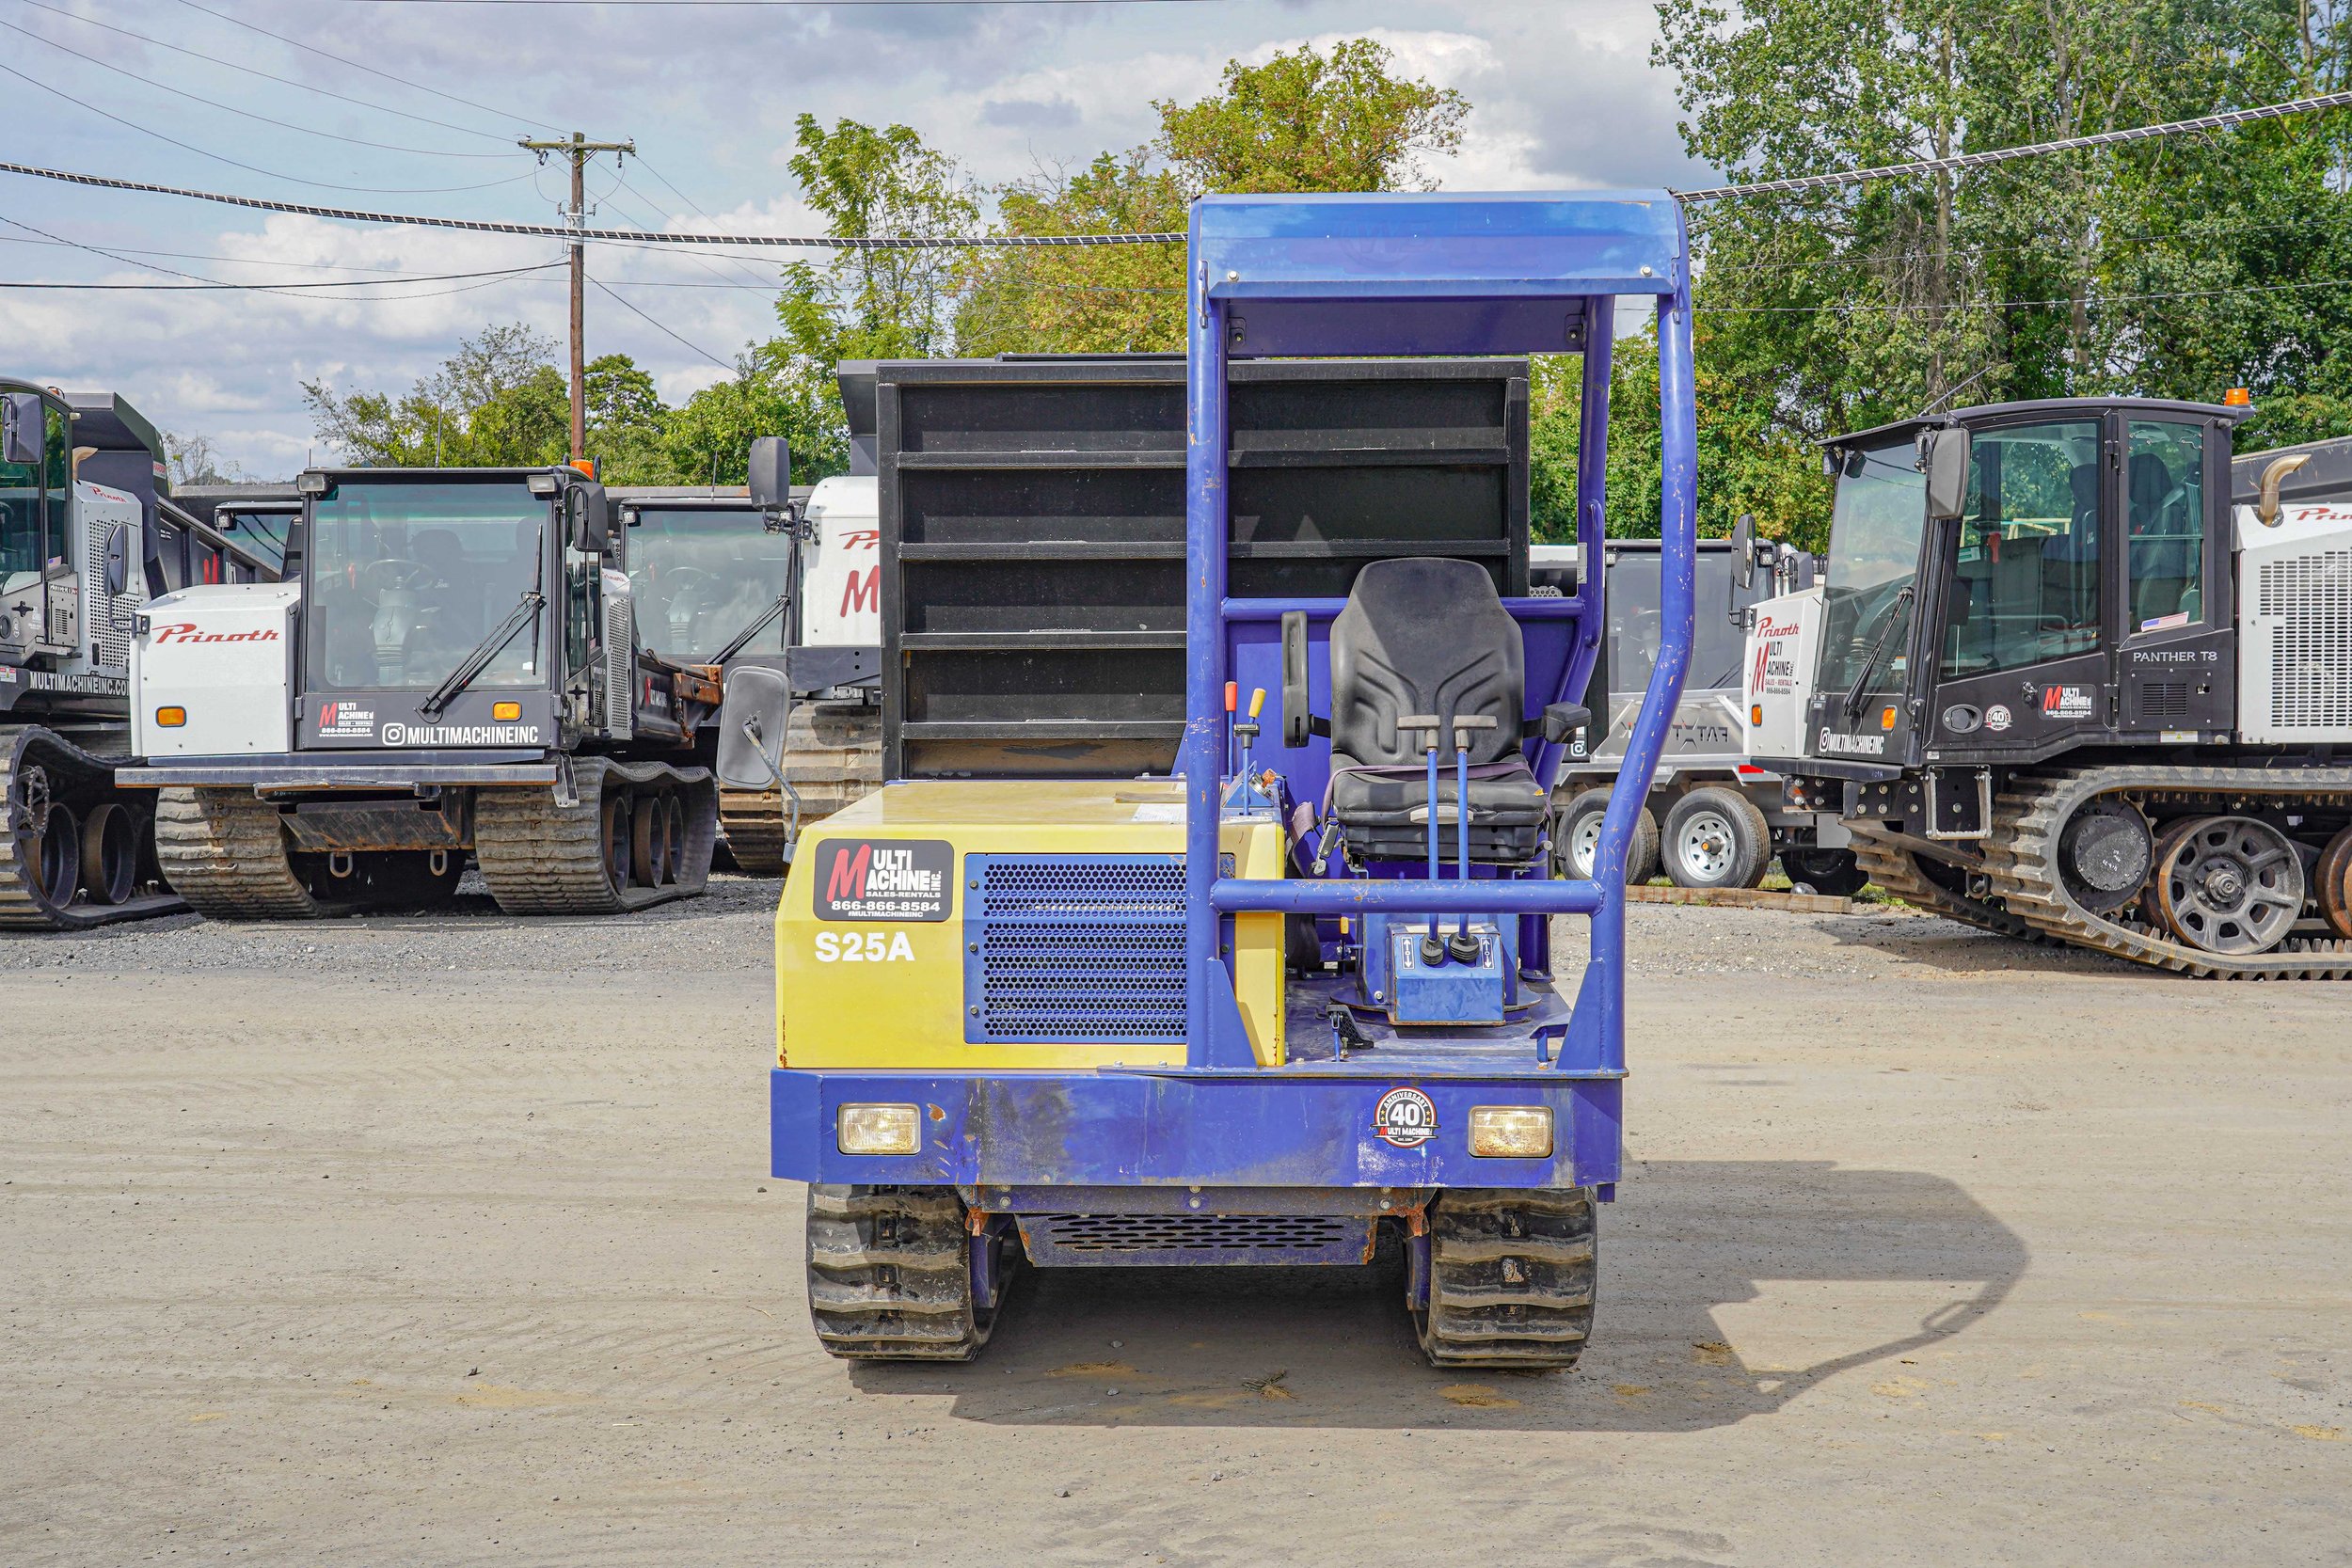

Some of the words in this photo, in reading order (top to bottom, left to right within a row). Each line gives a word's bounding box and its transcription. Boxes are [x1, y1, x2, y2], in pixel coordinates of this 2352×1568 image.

[151, 623, 278, 643] Prinoth
[1756, 616, 1799, 638] Prinoth
[2133, 651, 2196, 662] PANTHER
[2200, 651, 2218, 661] T8
[407, 726, 538, 744] MULTIMACHINEINC
[1828, 733, 1884, 755] MULTIMACHINEINC
[930, 871, 941, 891] INC.
[831, 900, 941, 911] 866-866-8584
[815, 931, 915, 962] S25A
[1383, 1091, 1429, 1109] ANNIVERSARY
[1390, 1103, 1421, 1126] 40
[1379, 1126, 1401, 1136] MULTI
[1402, 1127, 1430, 1136] MACHINE
